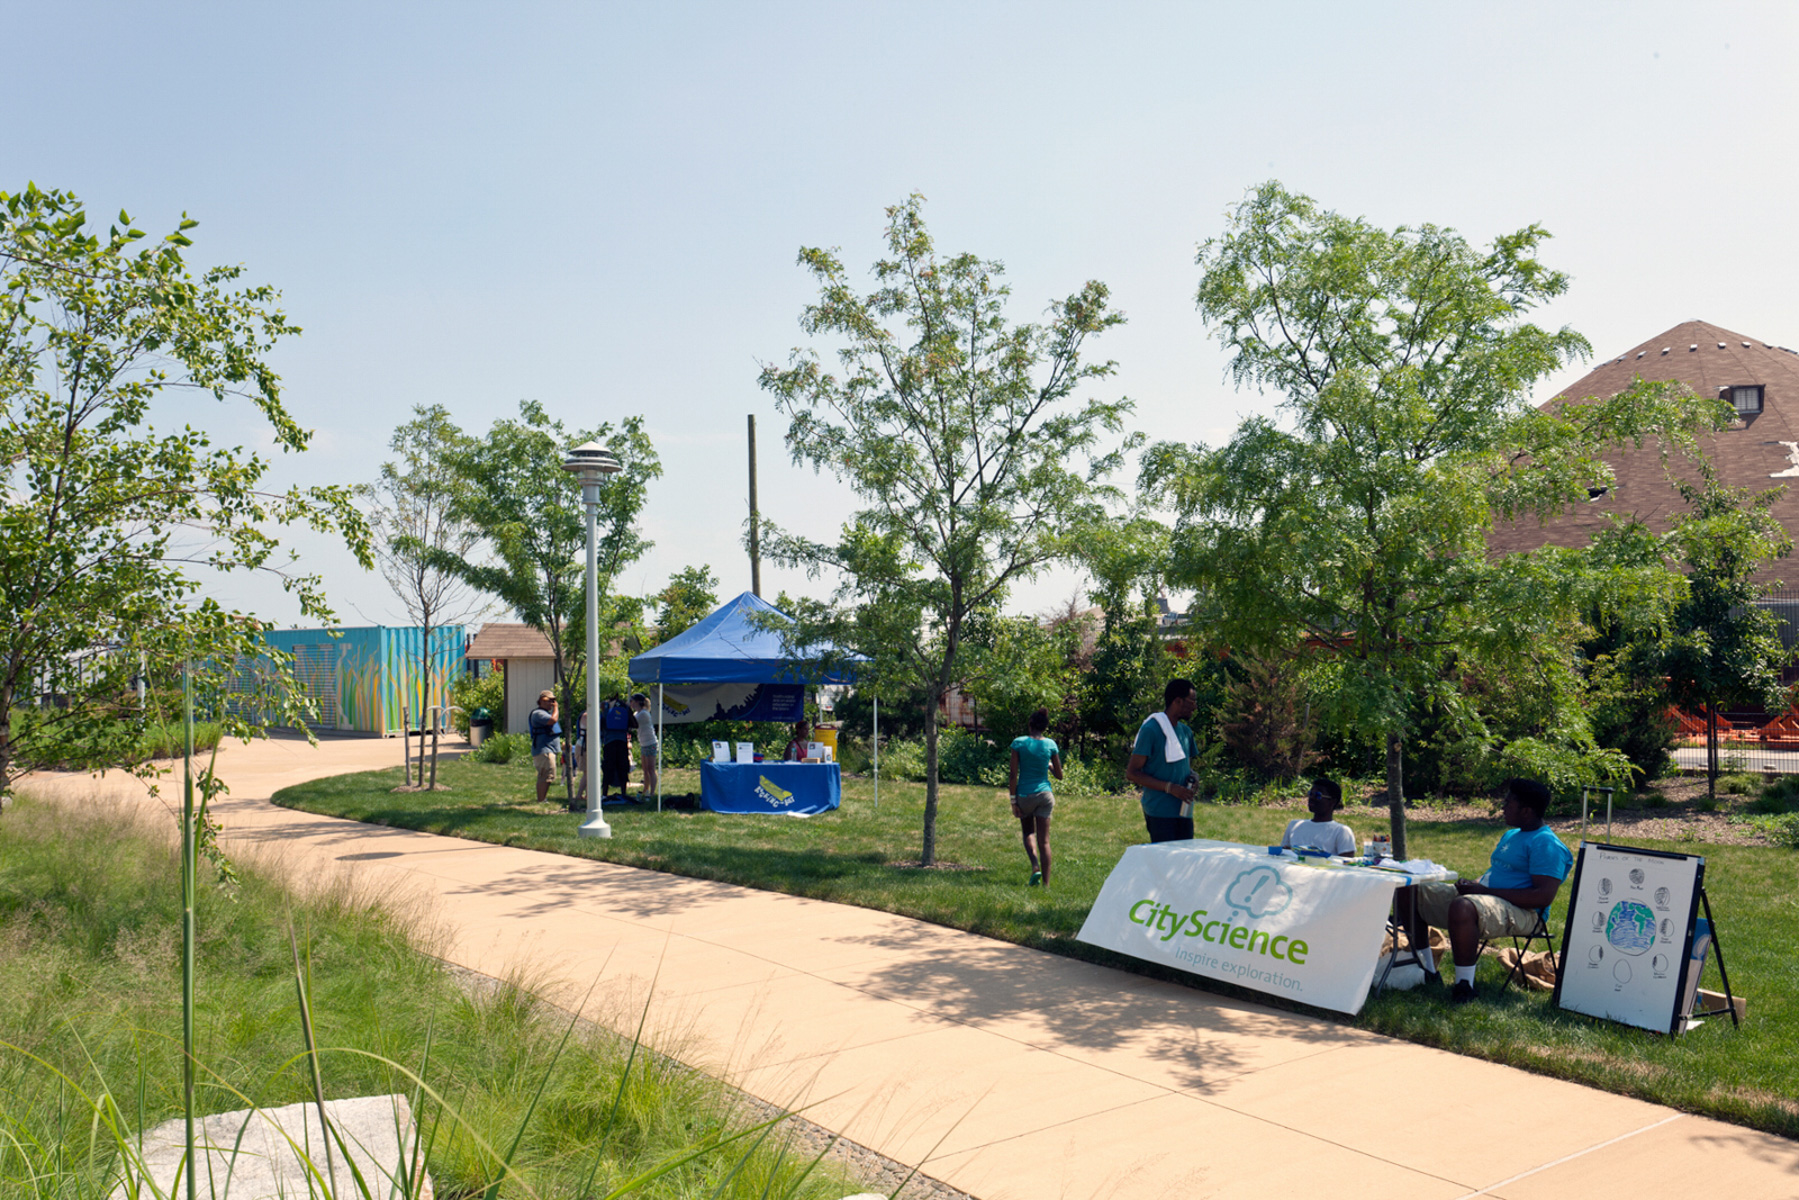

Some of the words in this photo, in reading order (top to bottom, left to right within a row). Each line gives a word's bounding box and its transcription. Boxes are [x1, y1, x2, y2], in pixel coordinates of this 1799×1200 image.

[1129, 899, 1309, 965] CityScience
[1175, 947, 1219, 967] Inspire
[1221, 961, 1303, 992] exploration.
